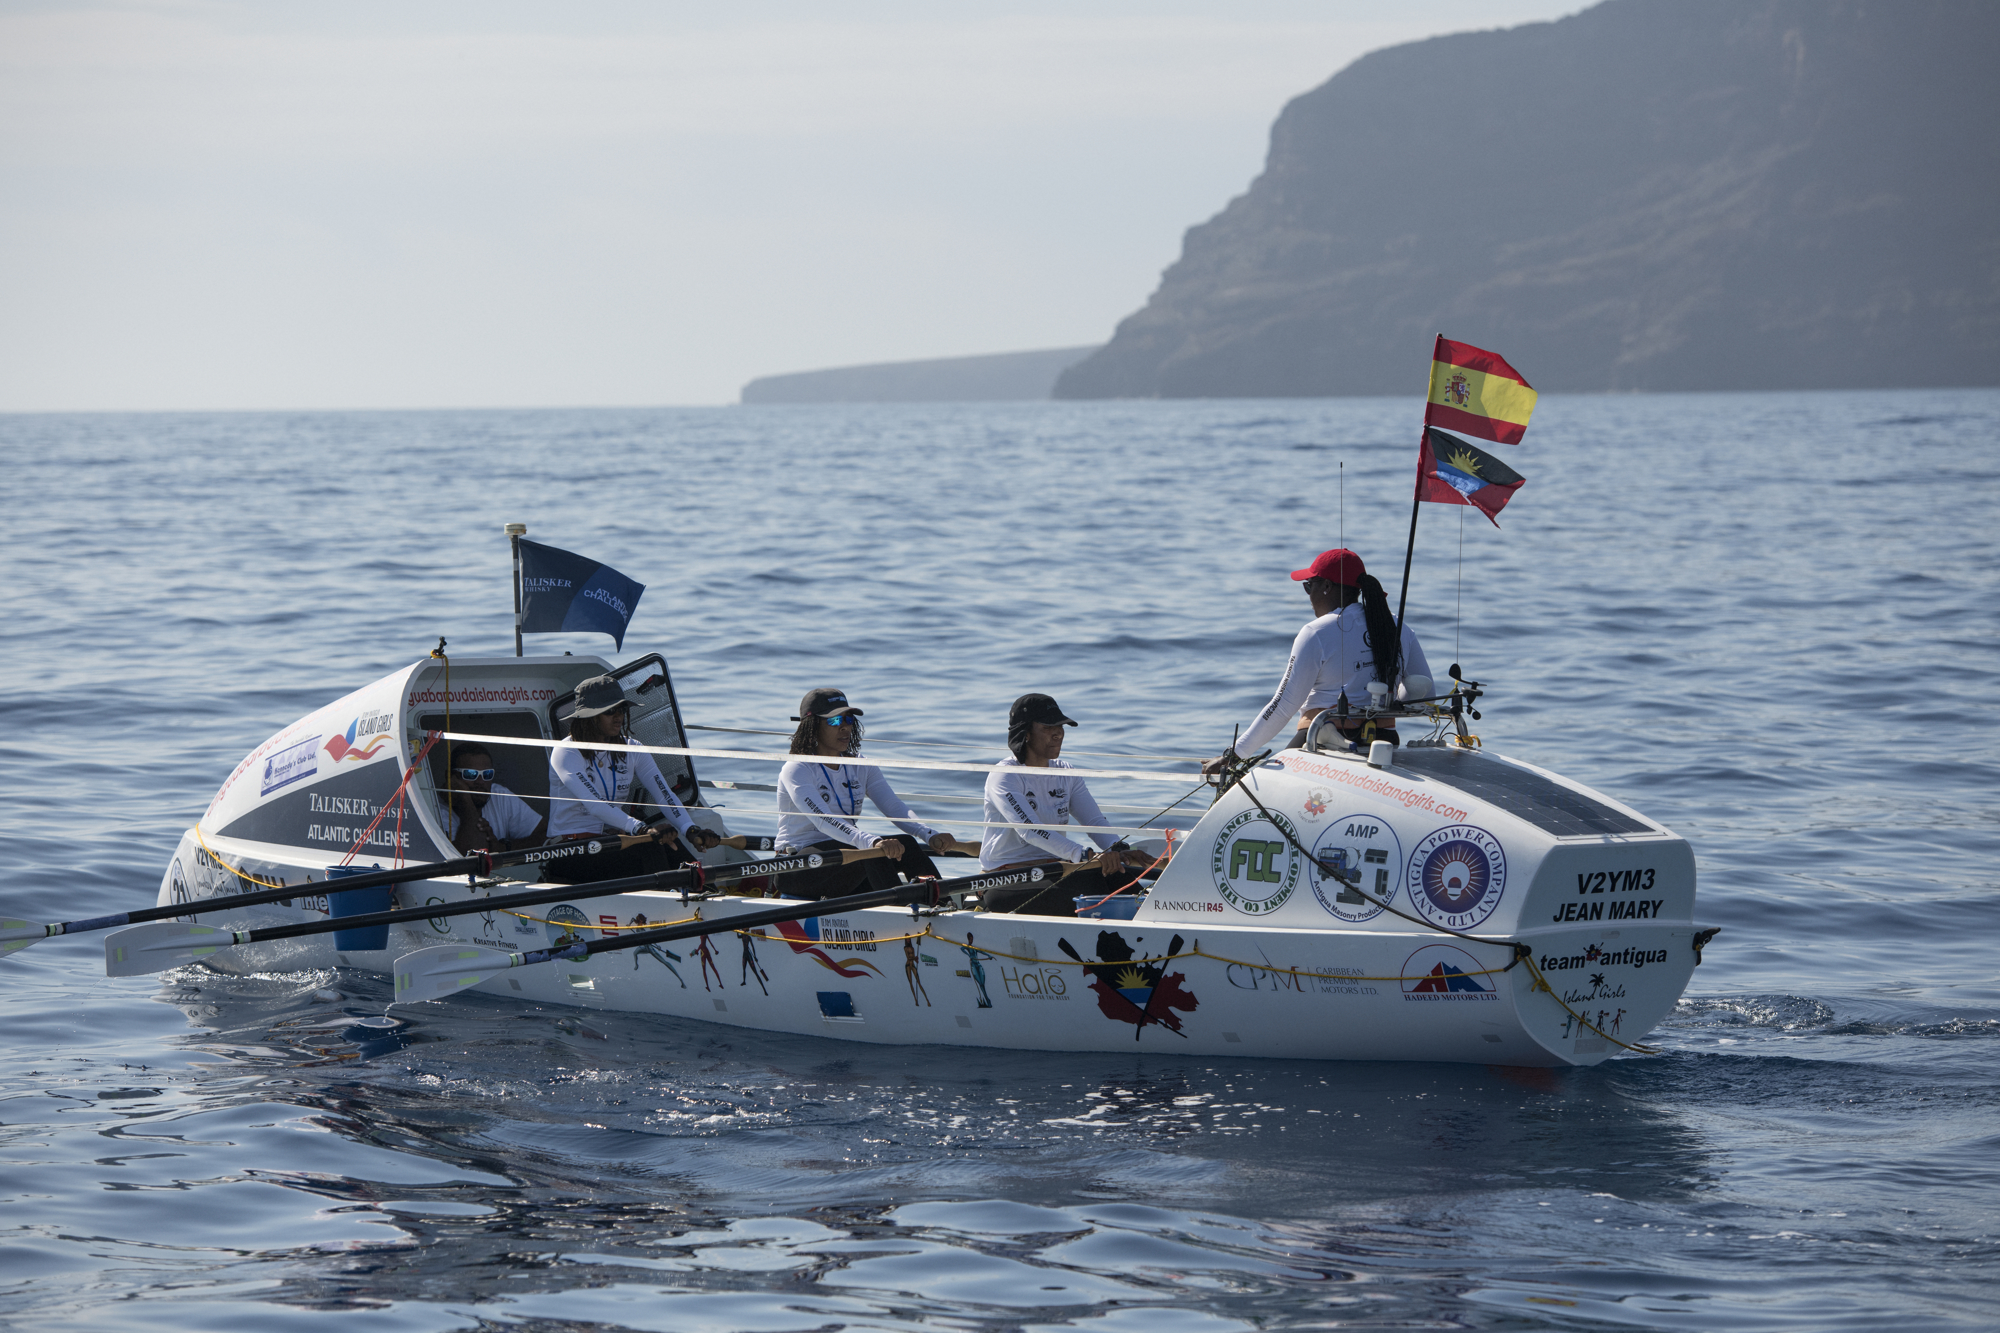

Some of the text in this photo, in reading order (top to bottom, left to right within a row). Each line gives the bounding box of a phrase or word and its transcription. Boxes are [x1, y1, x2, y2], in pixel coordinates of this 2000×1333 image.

[524, 577, 572, 588] TALISKER
[310, 793, 368, 816] TALISKER
[308, 824, 350, 842] ATLANTIC
[1344, 824, 1378, 838] AMP
[1214, 812, 1252, 874] FINANCE
[525, 845, 584, 863] RANNOCH
[741, 855, 804, 876] RANNOCH
[970, 872, 1027, 890] RANNOCH
[1411, 828, 1503, 926] ANTIGUA POWER COMPANY LTD
[1577, 868, 1656, 894] V2YM3
[1154, 900, 1223, 912] RANNOCH R45
[1314, 880, 1394, 921] Antigua Masonry Product Ltd.
[1553, 900, 1664, 922] JEAN MARY
[822, 928, 876, 952] ISLAND GIRLS
[1540, 947, 1667, 971] team antigua
[1001, 966, 1066, 995] Halo
[1316, 967, 1364, 976] CARIBBEAN
[1318, 976, 1359, 986] PREMIUM
[1321, 987, 1358, 995] MOTORS
[1563, 984, 1625, 1004] Island Girls
